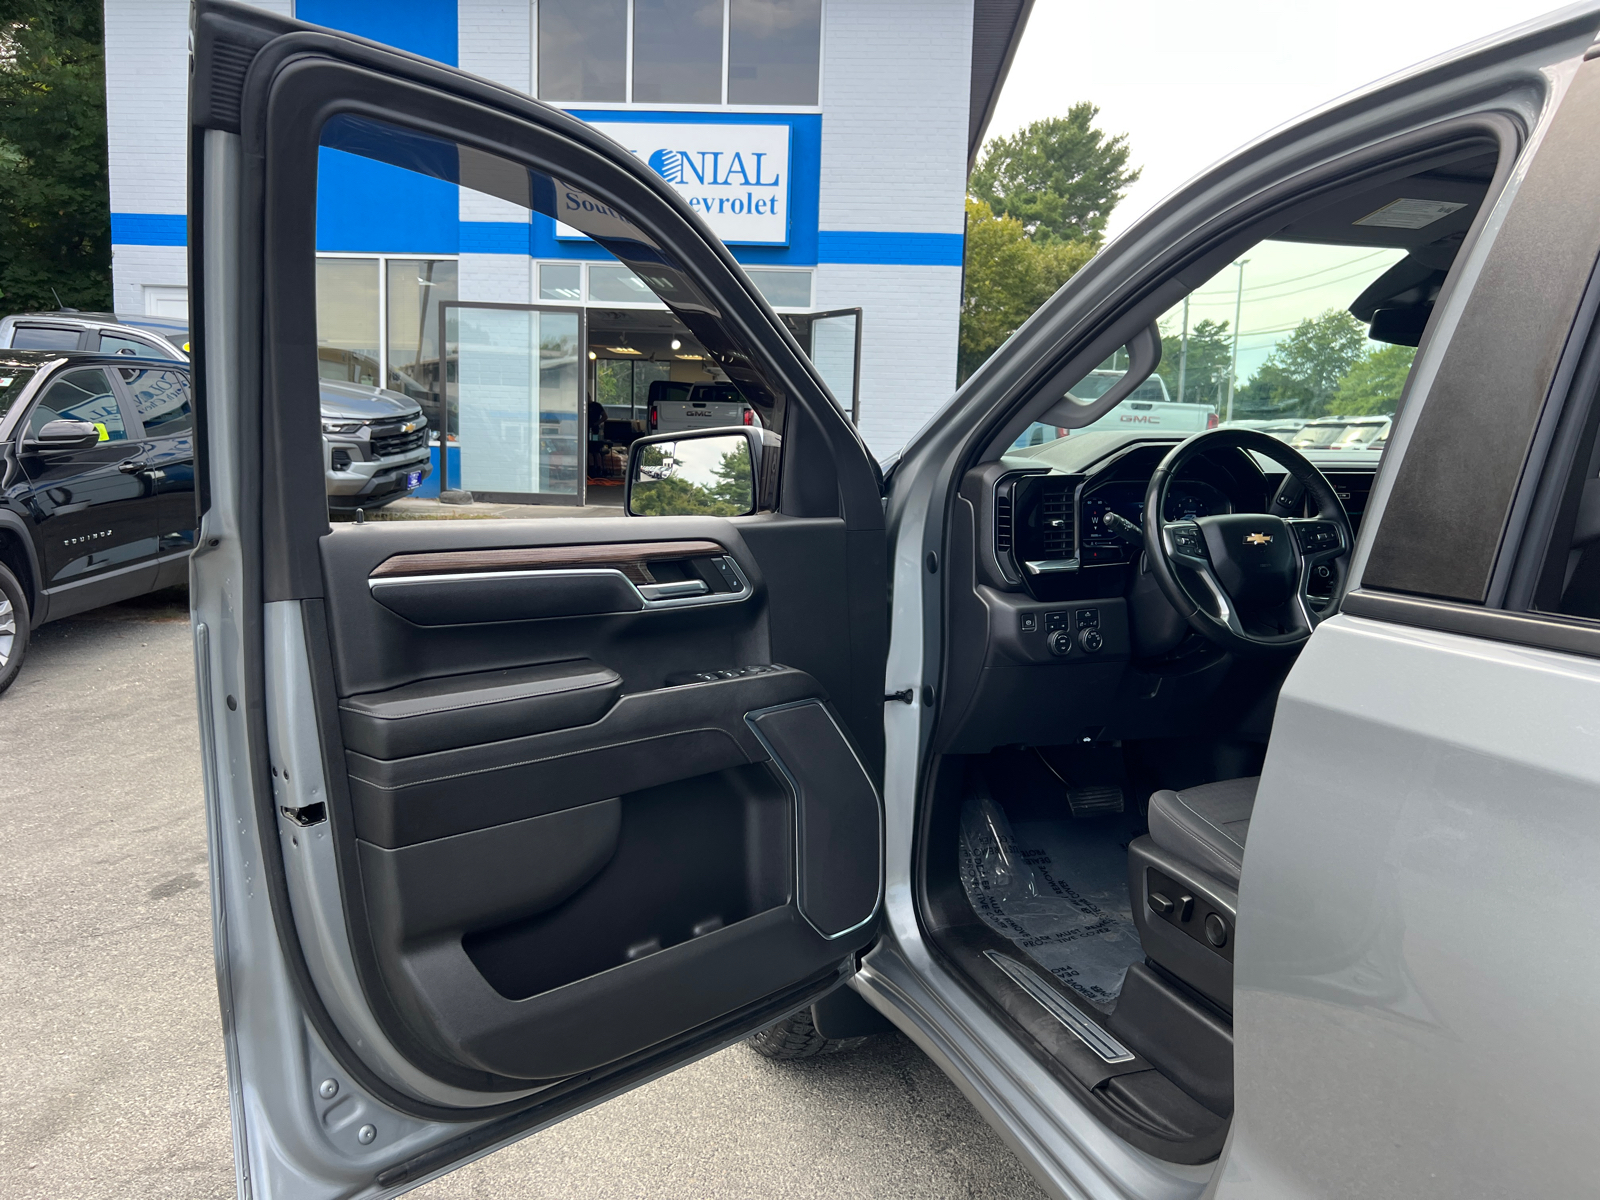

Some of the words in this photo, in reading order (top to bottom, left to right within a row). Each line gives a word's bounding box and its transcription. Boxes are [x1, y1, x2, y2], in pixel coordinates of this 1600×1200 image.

[632, 148, 780, 187] ONIAL
[687, 192, 779, 215] evrolet
[1120, 414, 1160, 424] GMC
[63, 529, 113, 546] EQUINOX
